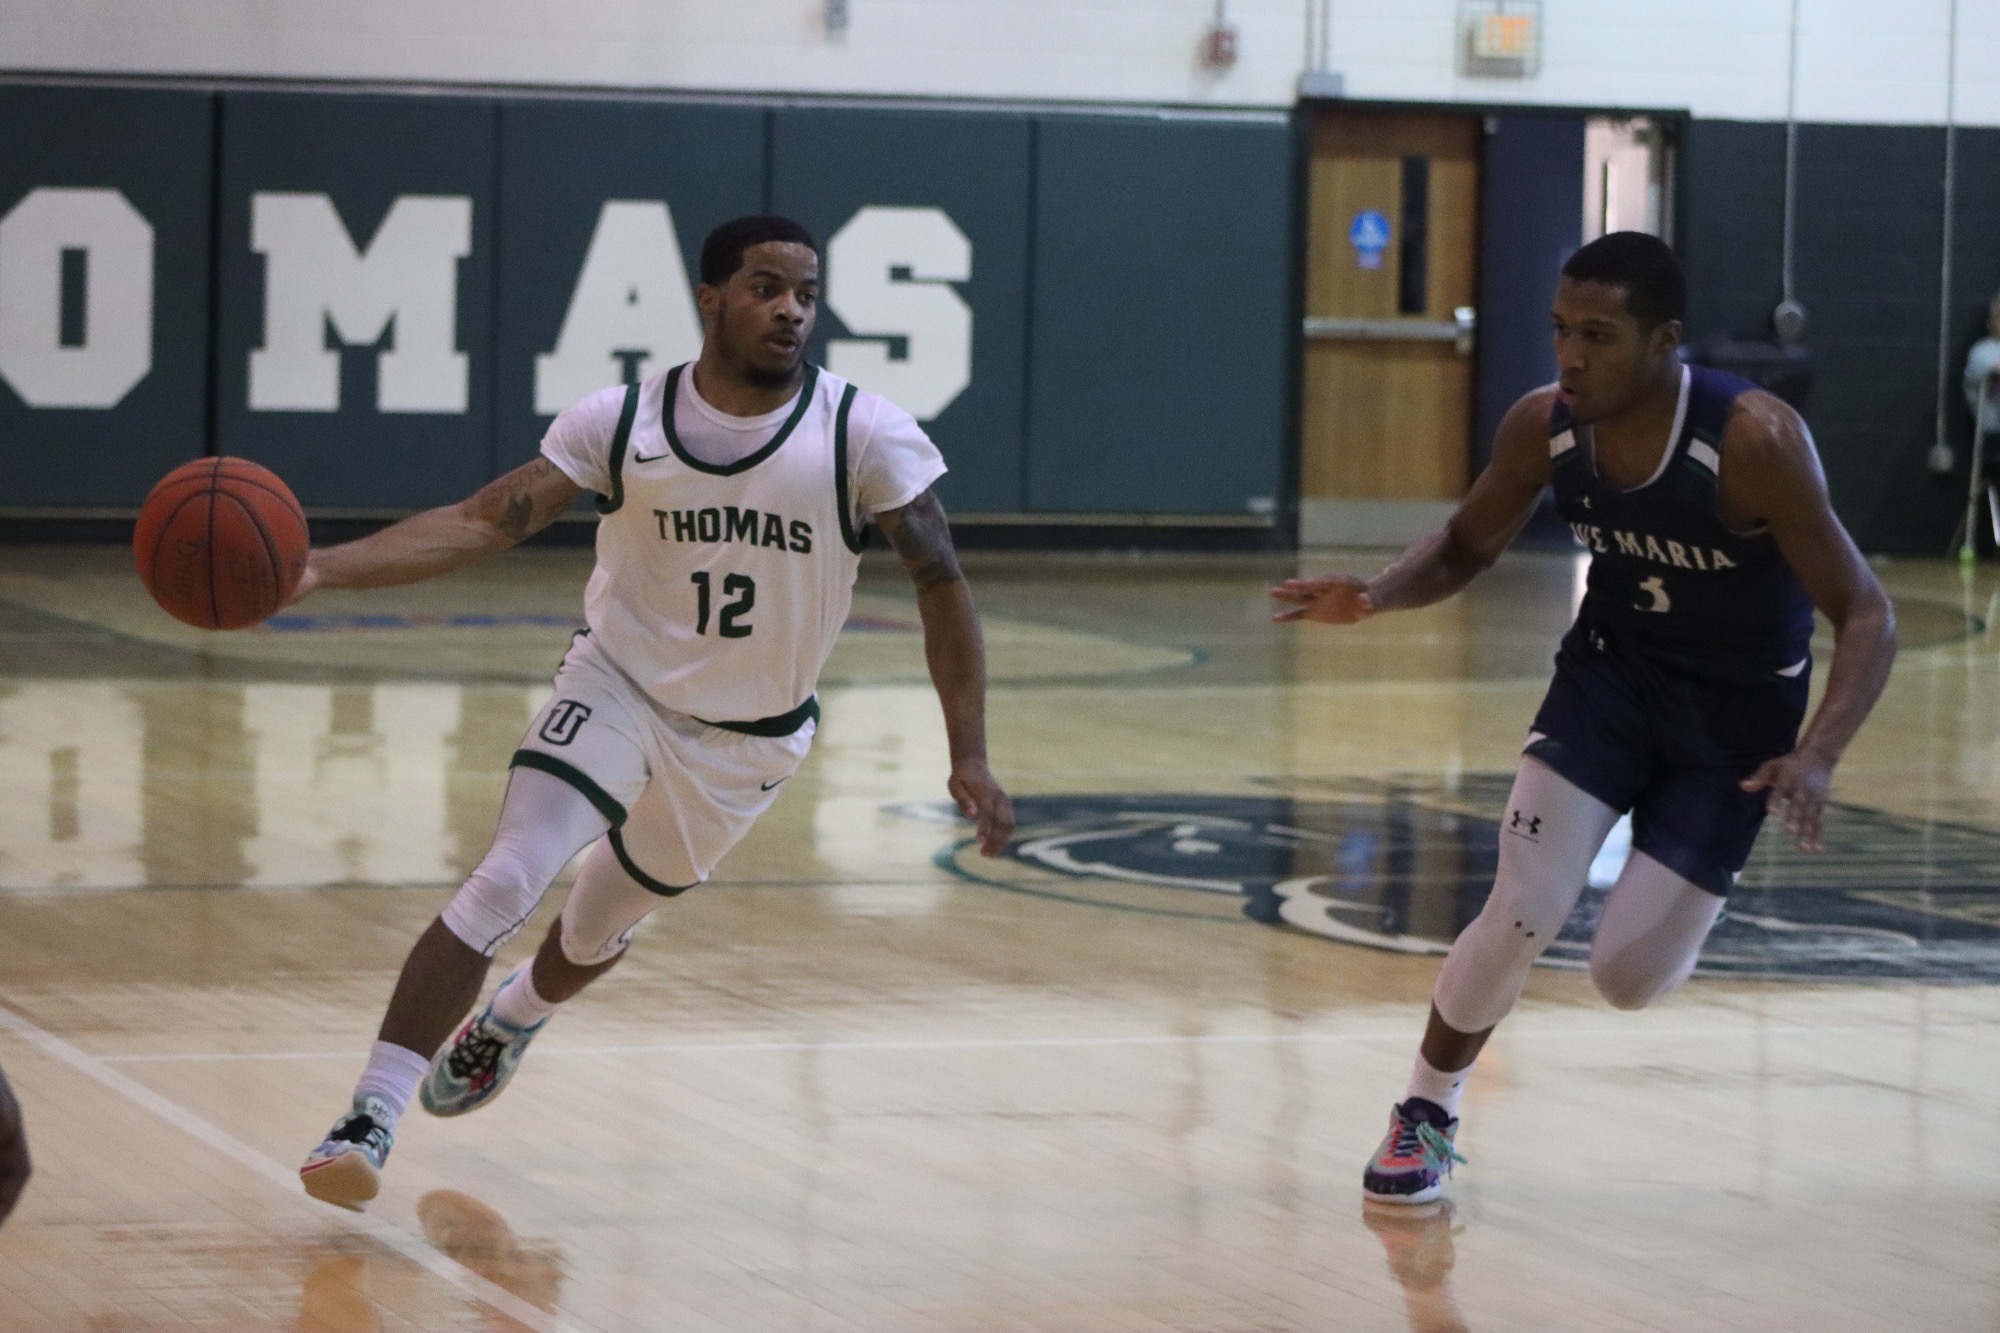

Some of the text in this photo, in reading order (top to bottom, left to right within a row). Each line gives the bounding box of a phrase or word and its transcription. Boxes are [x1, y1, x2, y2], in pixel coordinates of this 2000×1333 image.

[653, 506, 813, 554] THOMAS
[1613, 530, 1738, 570] MARIA
[691, 571, 756, 638] 12
